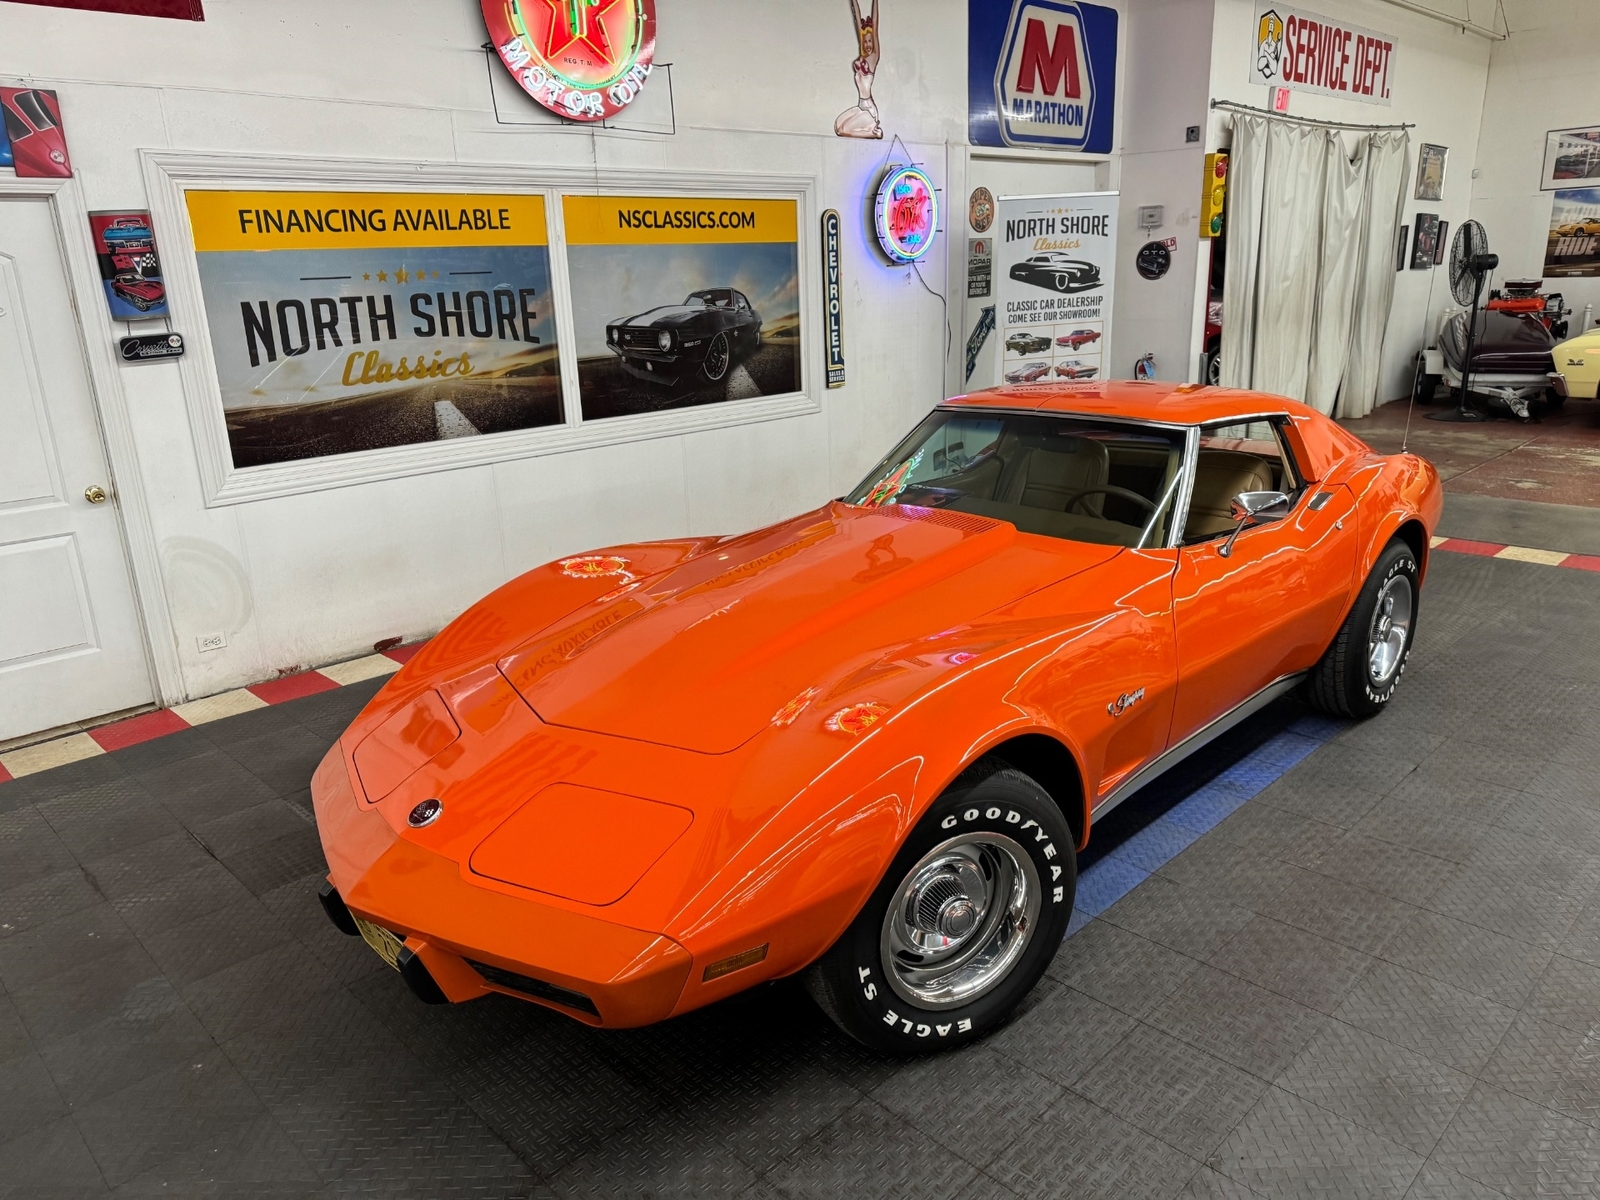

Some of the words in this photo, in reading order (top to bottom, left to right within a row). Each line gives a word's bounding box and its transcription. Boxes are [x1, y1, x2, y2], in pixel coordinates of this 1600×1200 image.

[1282, 14, 1352, 91] SERVICE
[1352, 34, 1393, 99] DEPT.
[500, 37, 605, 117] MOTOR
[608, 64, 653, 106] OIL
[1012, 98, 1084, 127] MARATHON
[238, 208, 387, 234] FINANCING
[392, 208, 511, 231] AVAILABLE
[617, 209, 756, 229] NSCLASSICS.COM
[975, 213, 991, 230] BEE
[1006, 217, 1056, 243] NORTH
[1060, 215, 1109, 237] SHORE
[1033, 237, 1081, 251] Classics
[1554, 236, 1598, 256] RIDE
[968, 258, 991, 266] MOPAR
[828, 218, 840, 361] CHEVROLET
[1006, 300, 1038, 312] CLASSIC
[1040, 299, 1055, 310] CAR
[1057, 295, 1104, 309] DEALERSHIP
[240, 294, 397, 368] NORTH
[409, 288, 541, 344] SHORE
[1008, 313, 1028, 324] COME
[1029, 312, 1042, 322] SEE
[1044, 311, 1058, 321] OUR
[1059, 308, 1101, 320] SHOWROOM!
[122, 339, 169, 358] Corvette
[341, 350, 476, 387] Classics
[1406, 560, 1416, 574] ST
[1365, 650, 1411, 704] GOODYEAR
[940, 807, 1064, 904] GOODYEAR
[857, 965, 879, 1001] ST
[882, 1008, 973, 1038] EAGLE
